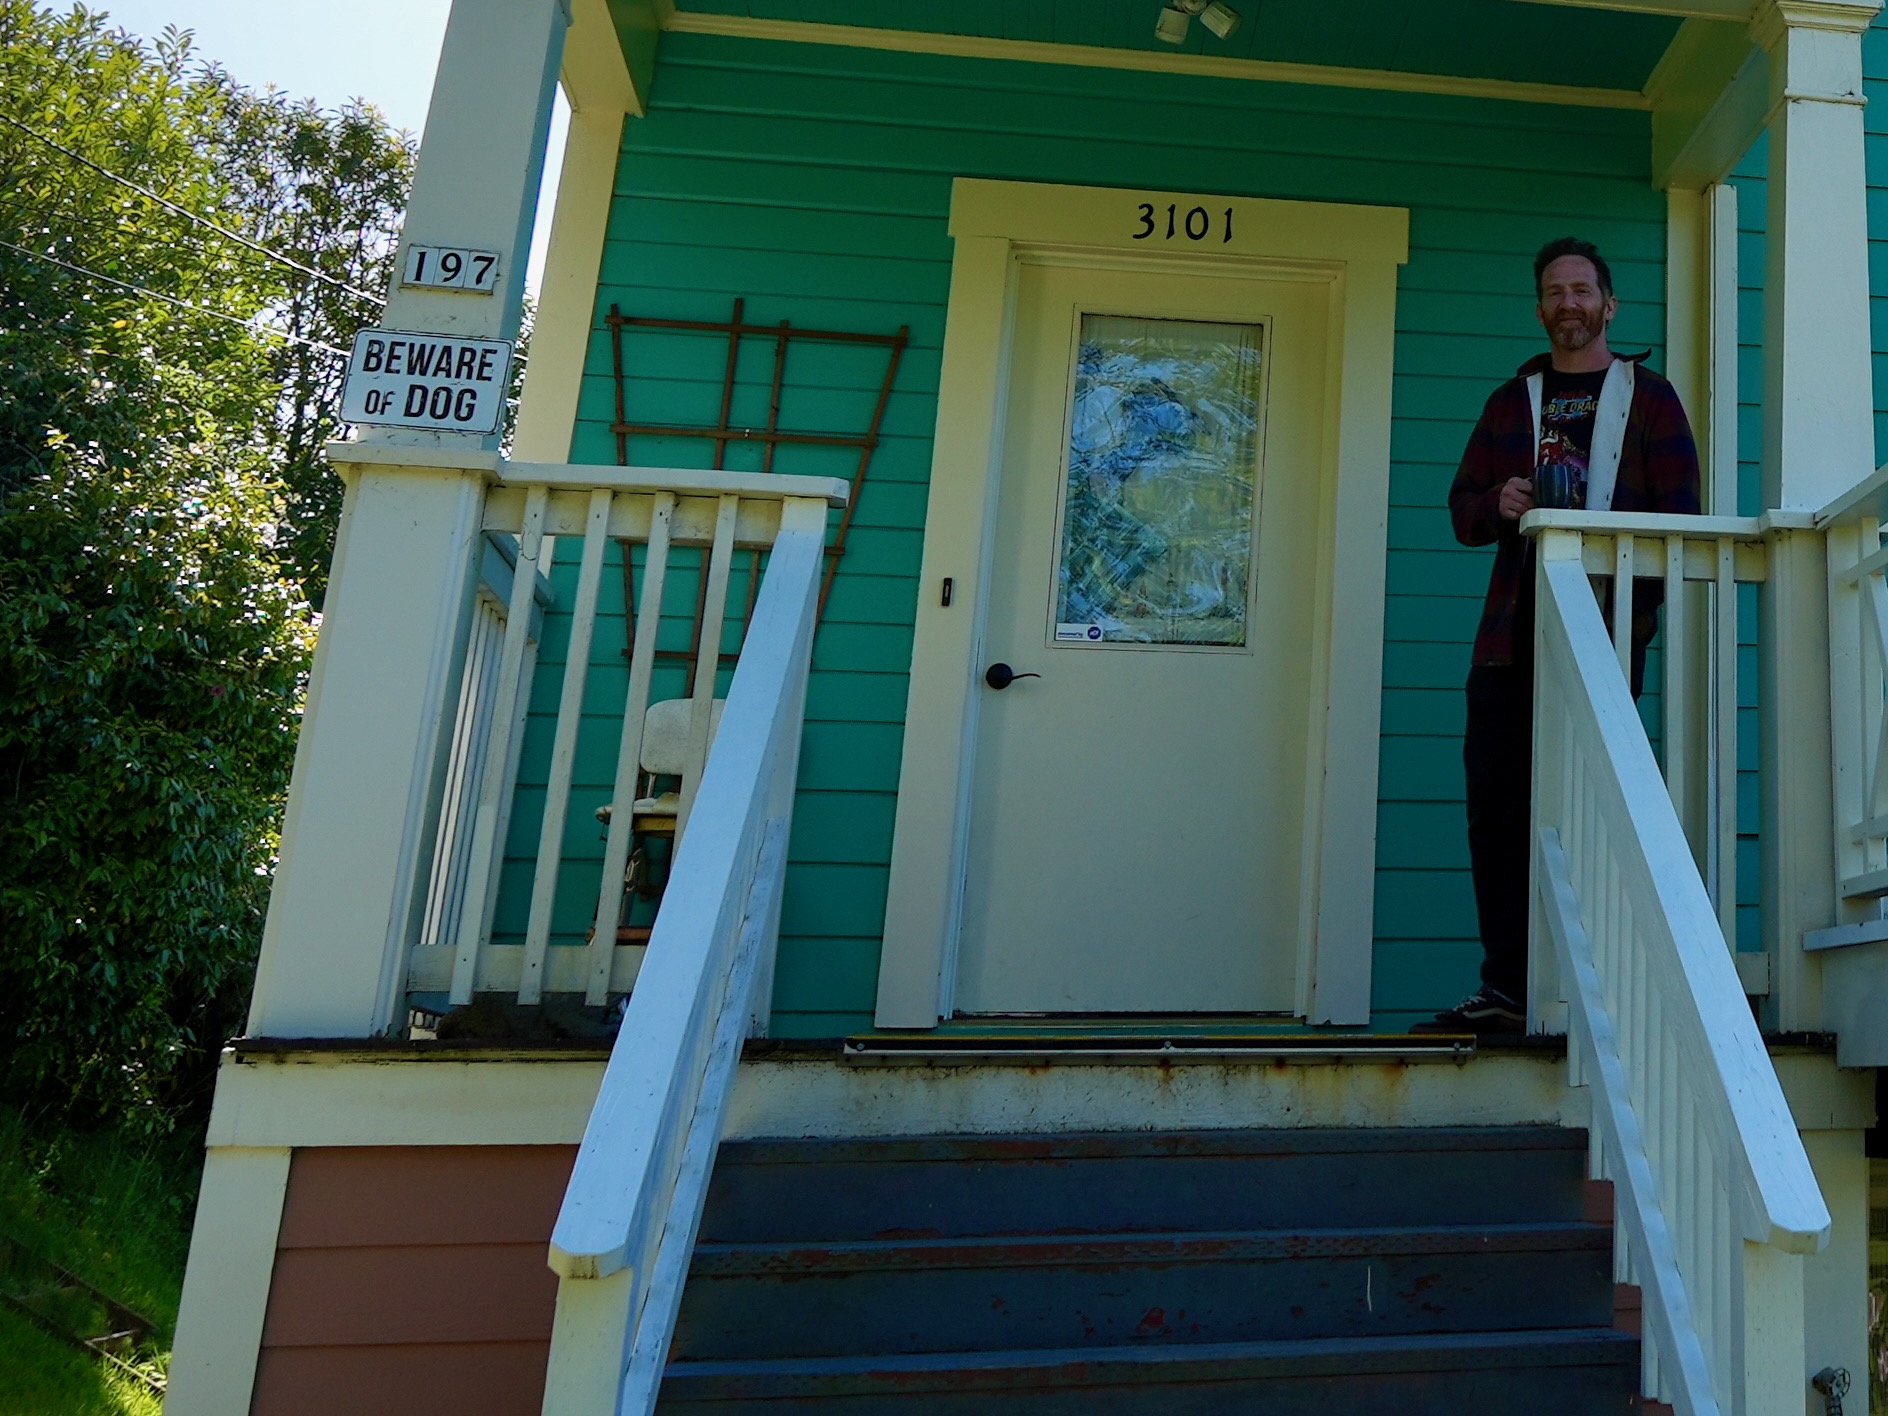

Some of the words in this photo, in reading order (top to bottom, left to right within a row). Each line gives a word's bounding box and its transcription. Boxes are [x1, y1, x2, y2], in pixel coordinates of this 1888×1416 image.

[1132, 203, 1233, 243] 3101
[413, 251, 496, 285] 197
[363, 339, 498, 382] BEWARE
[364, 389, 396, 415] OF
[403, 384, 478, 422] DOG
[1541, 402, 1567, 415] UBLE
